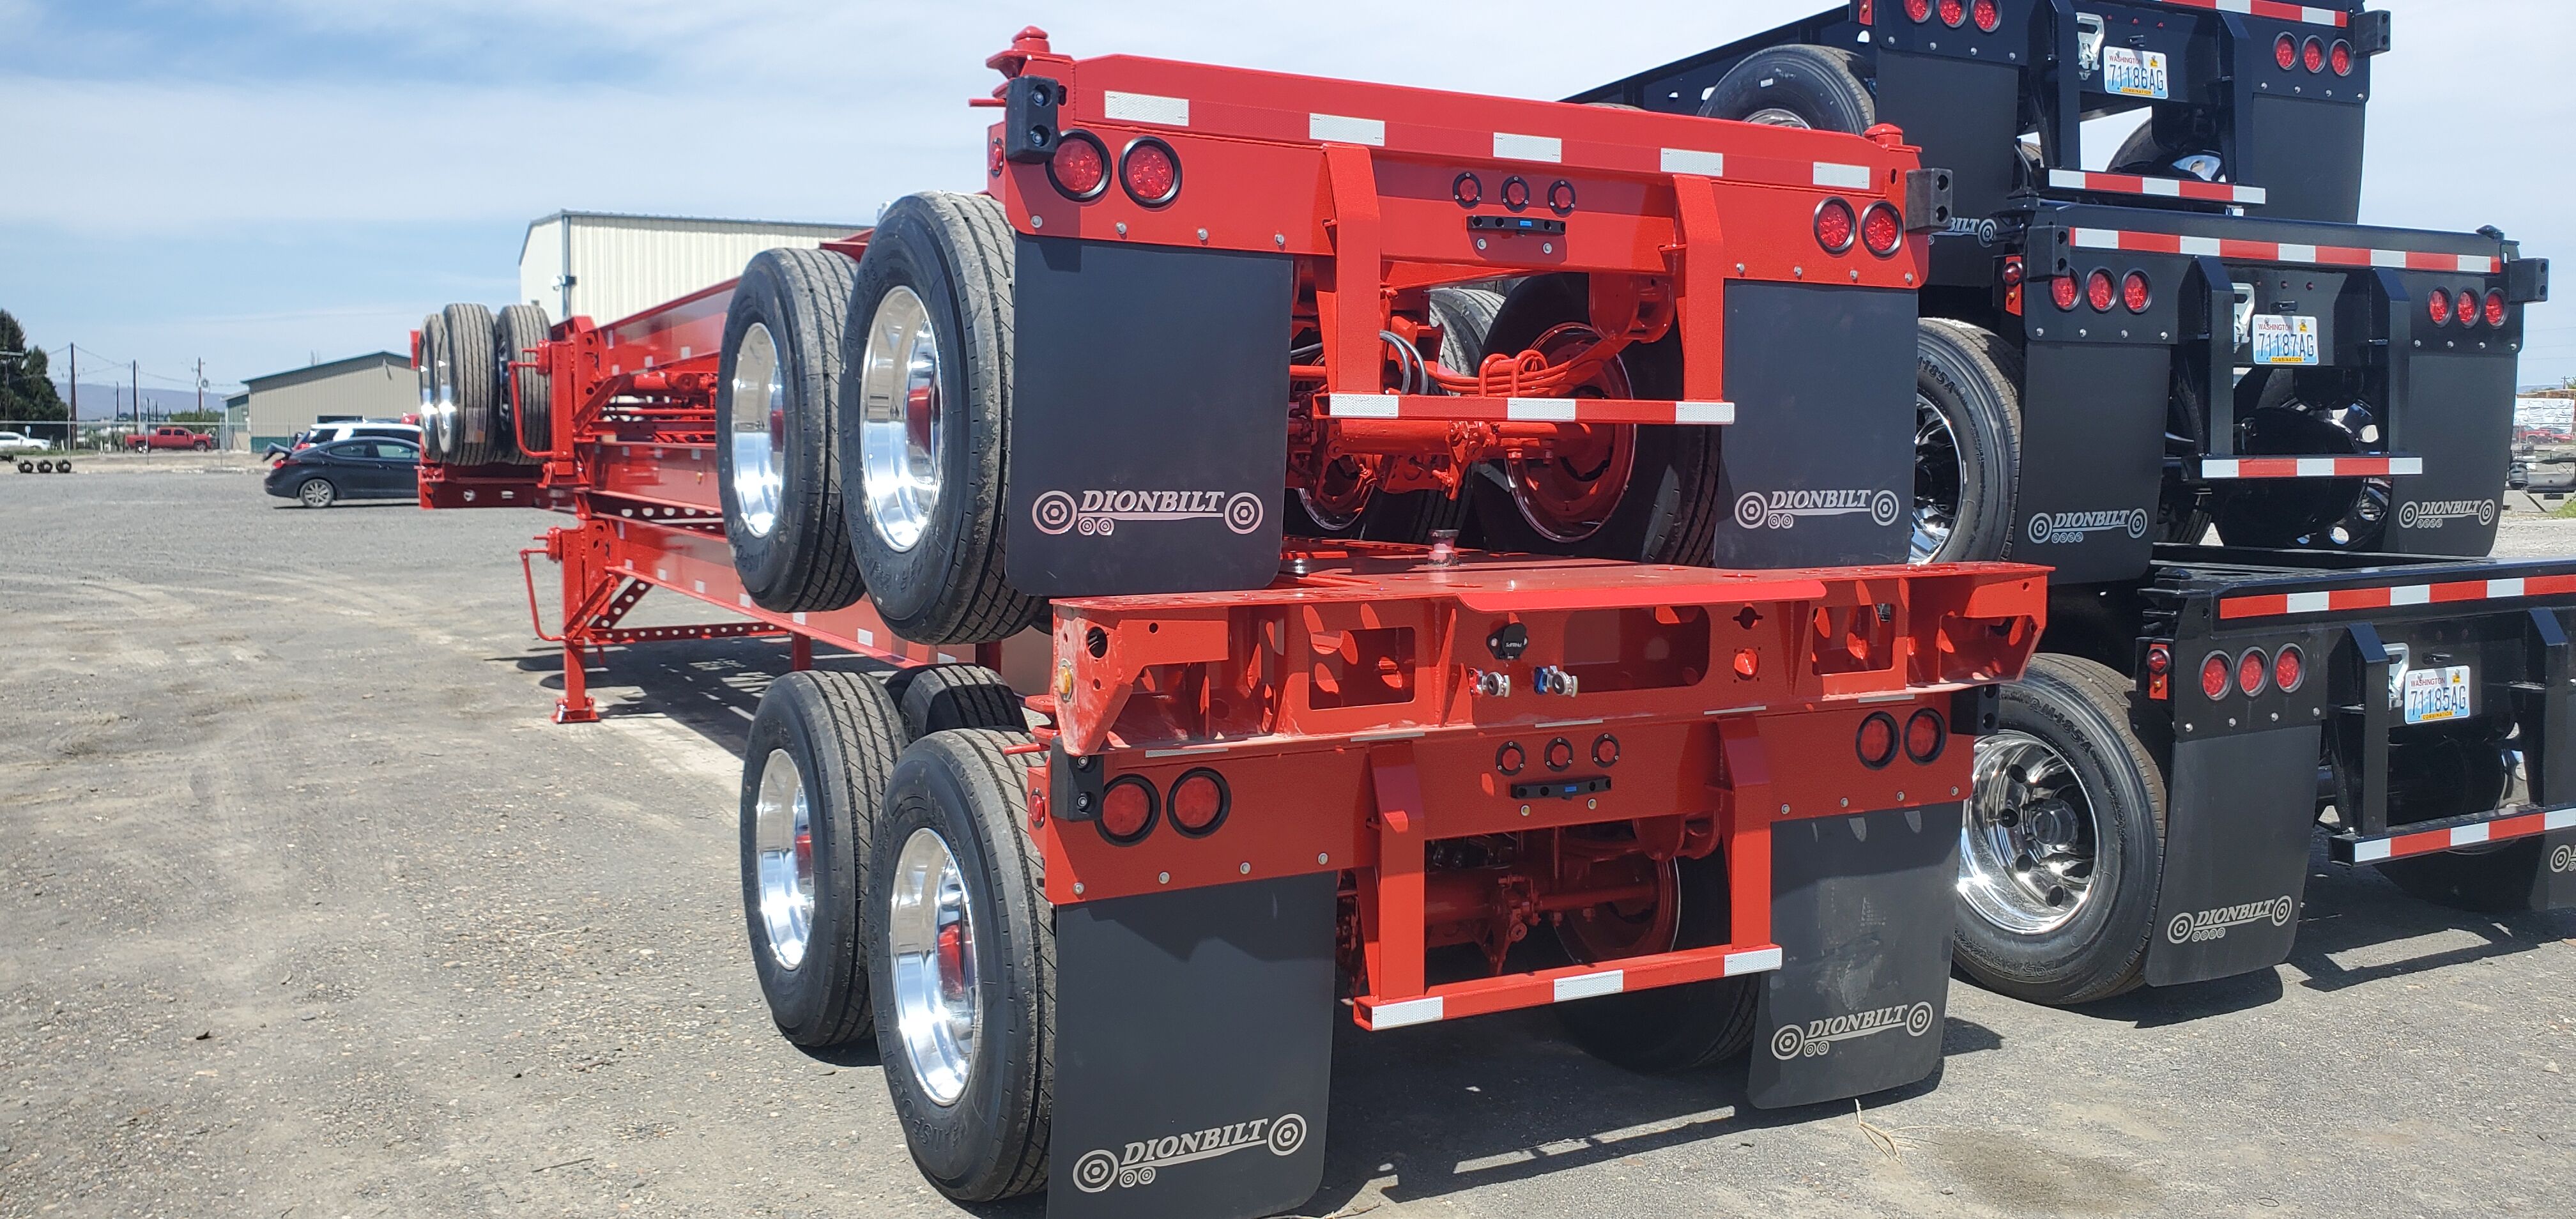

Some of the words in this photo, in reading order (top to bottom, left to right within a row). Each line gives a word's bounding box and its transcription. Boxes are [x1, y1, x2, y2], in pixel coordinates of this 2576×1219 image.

[2109, 56, 2142, 65] WASHINGTON
[2110, 64, 2163, 91] 71186AG
[1945, 217, 1980, 233] BILT
[2258, 333, 2314, 356] 71187AG
[1080, 490, 1225, 512] DIONBILT
[1769, 489, 1871, 509] DIONBILT
[2419, 500, 2481, 515] DIONBILT
[2053, 510, 2129, 528] DIONBILT
[2411, 677, 2445, 687] WASHINGTON
[2411, 686, 2465, 716] 71185AG
[2194, 899, 2274, 926] DIONBILT
[1806, 1004, 1908, 1039] DIONBILT
[1121, 1118, 1268, 1165] DIONBILT
